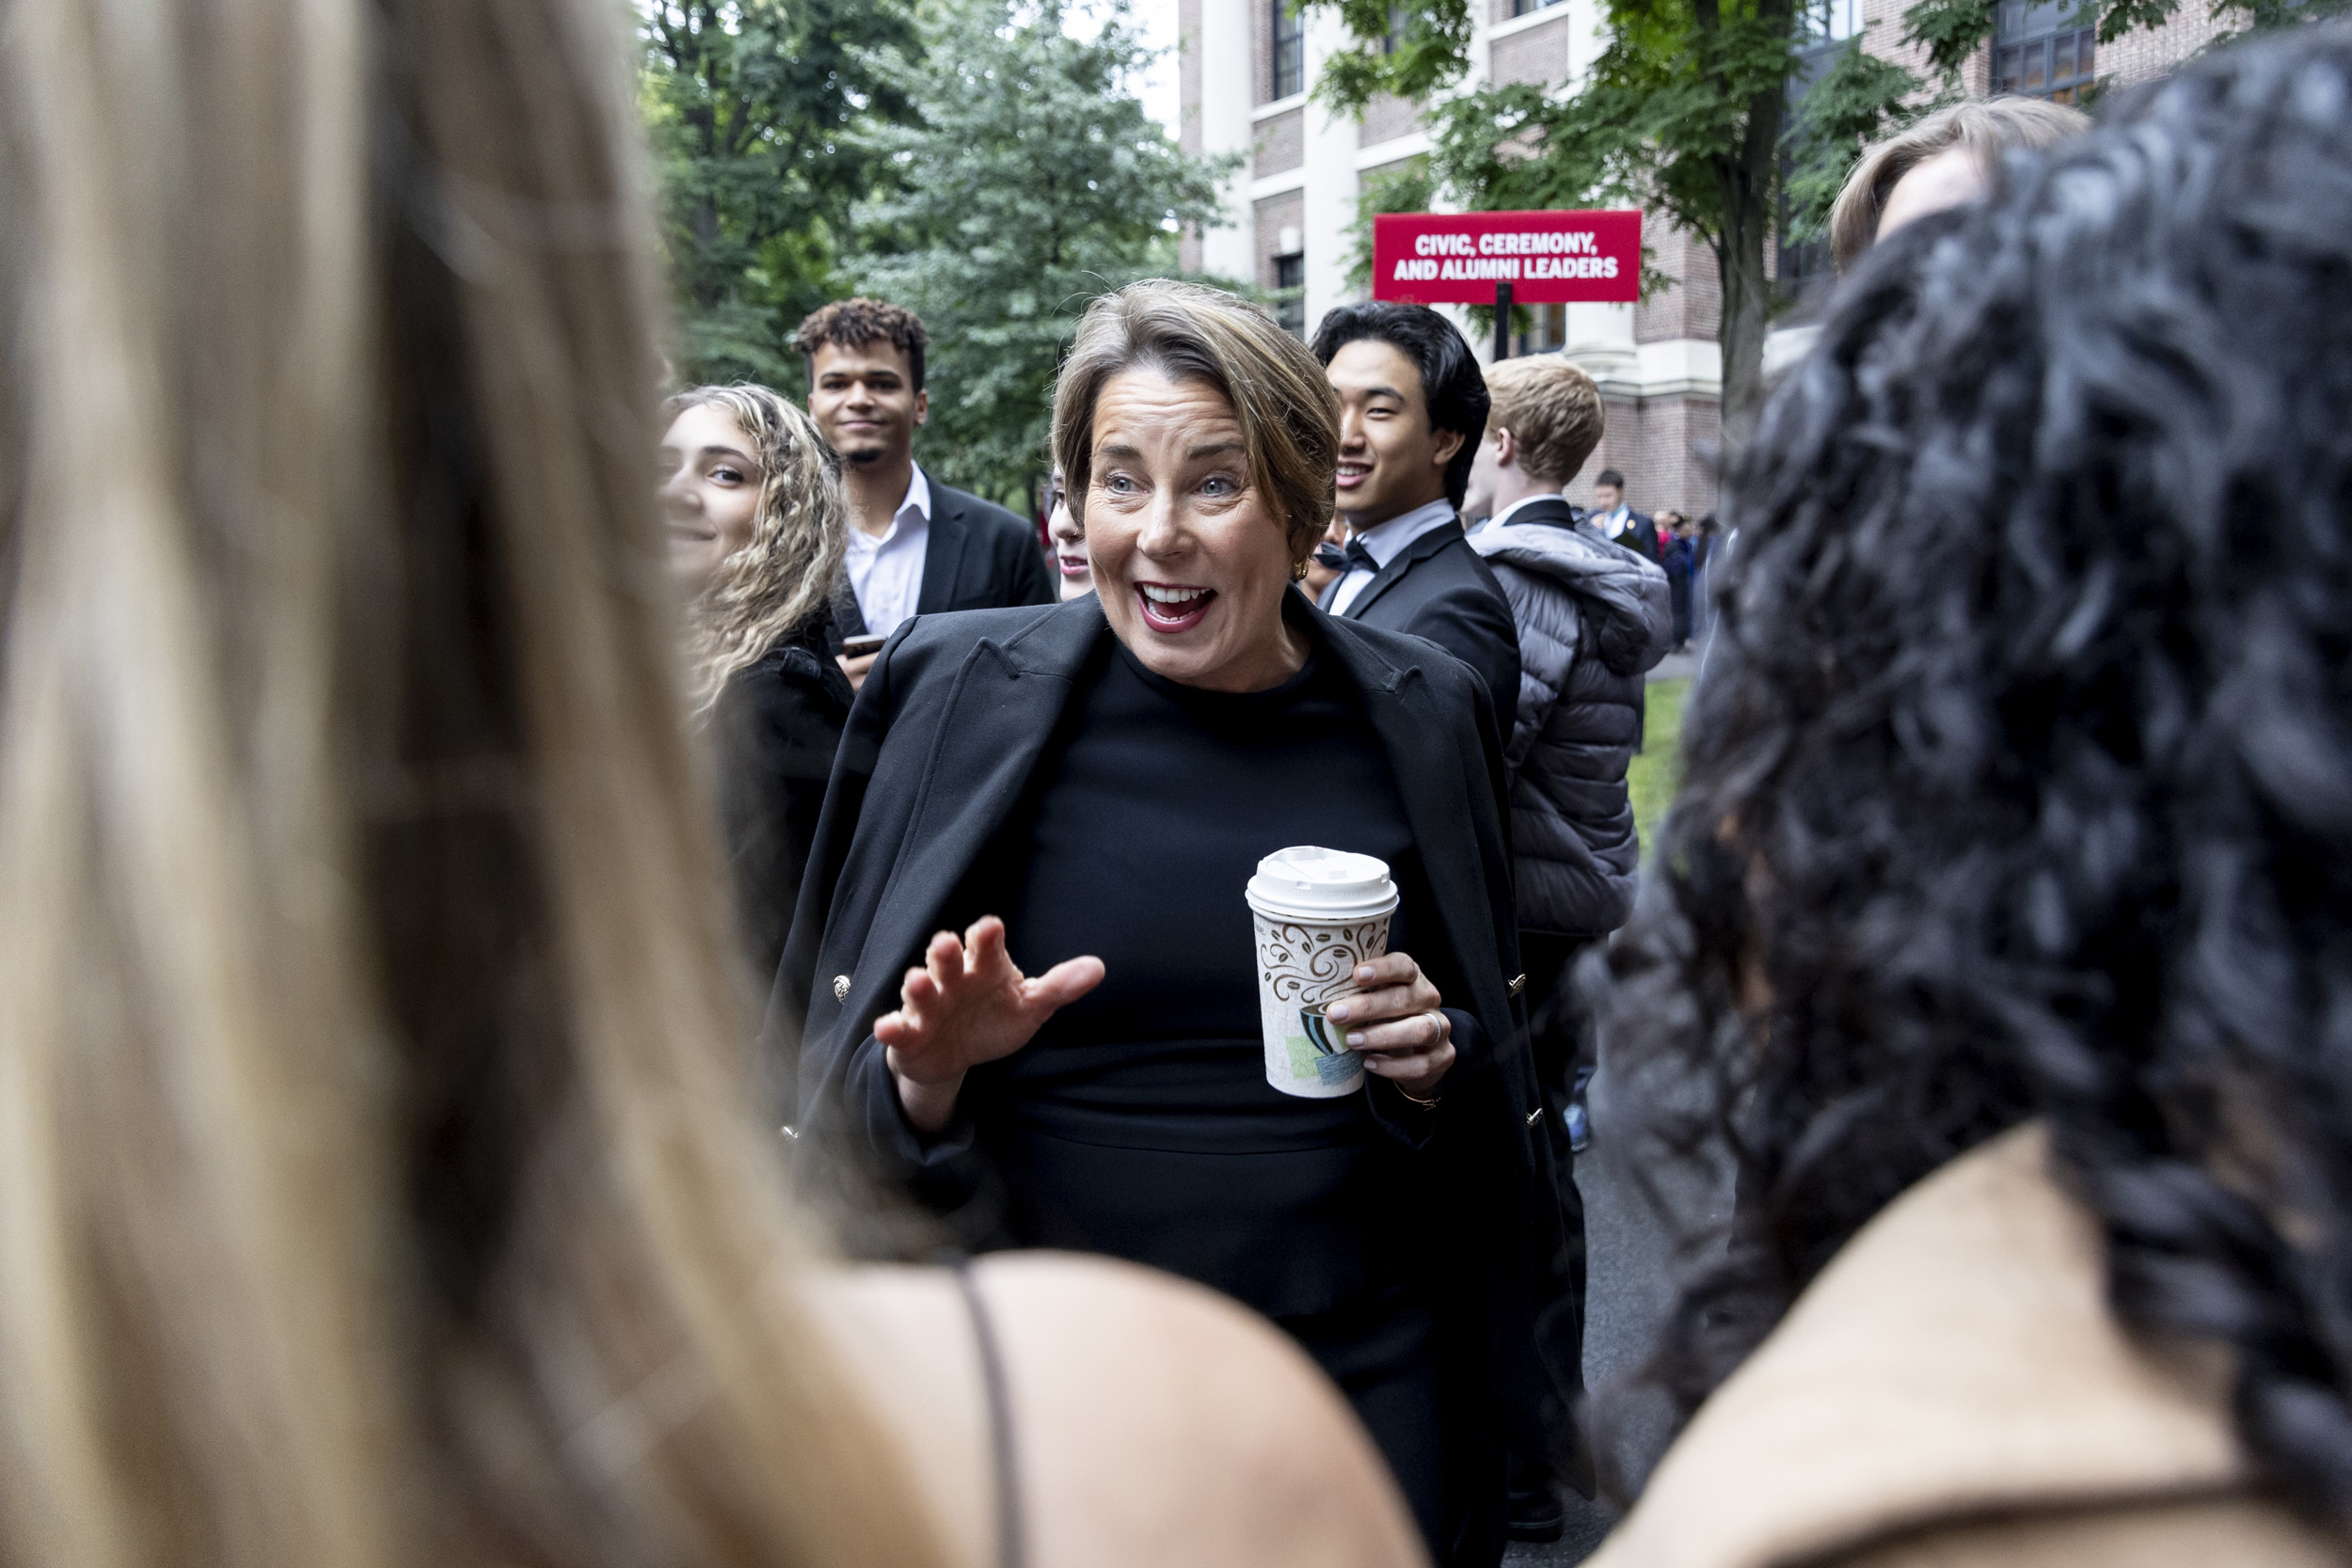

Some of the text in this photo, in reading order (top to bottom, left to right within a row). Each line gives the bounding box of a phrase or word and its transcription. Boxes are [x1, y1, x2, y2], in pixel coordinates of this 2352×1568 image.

[1415, 231, 1598, 258] CIVIC, CEREMONY,
[1393, 256, 1619, 280] AND ALUMNI LEADERS
